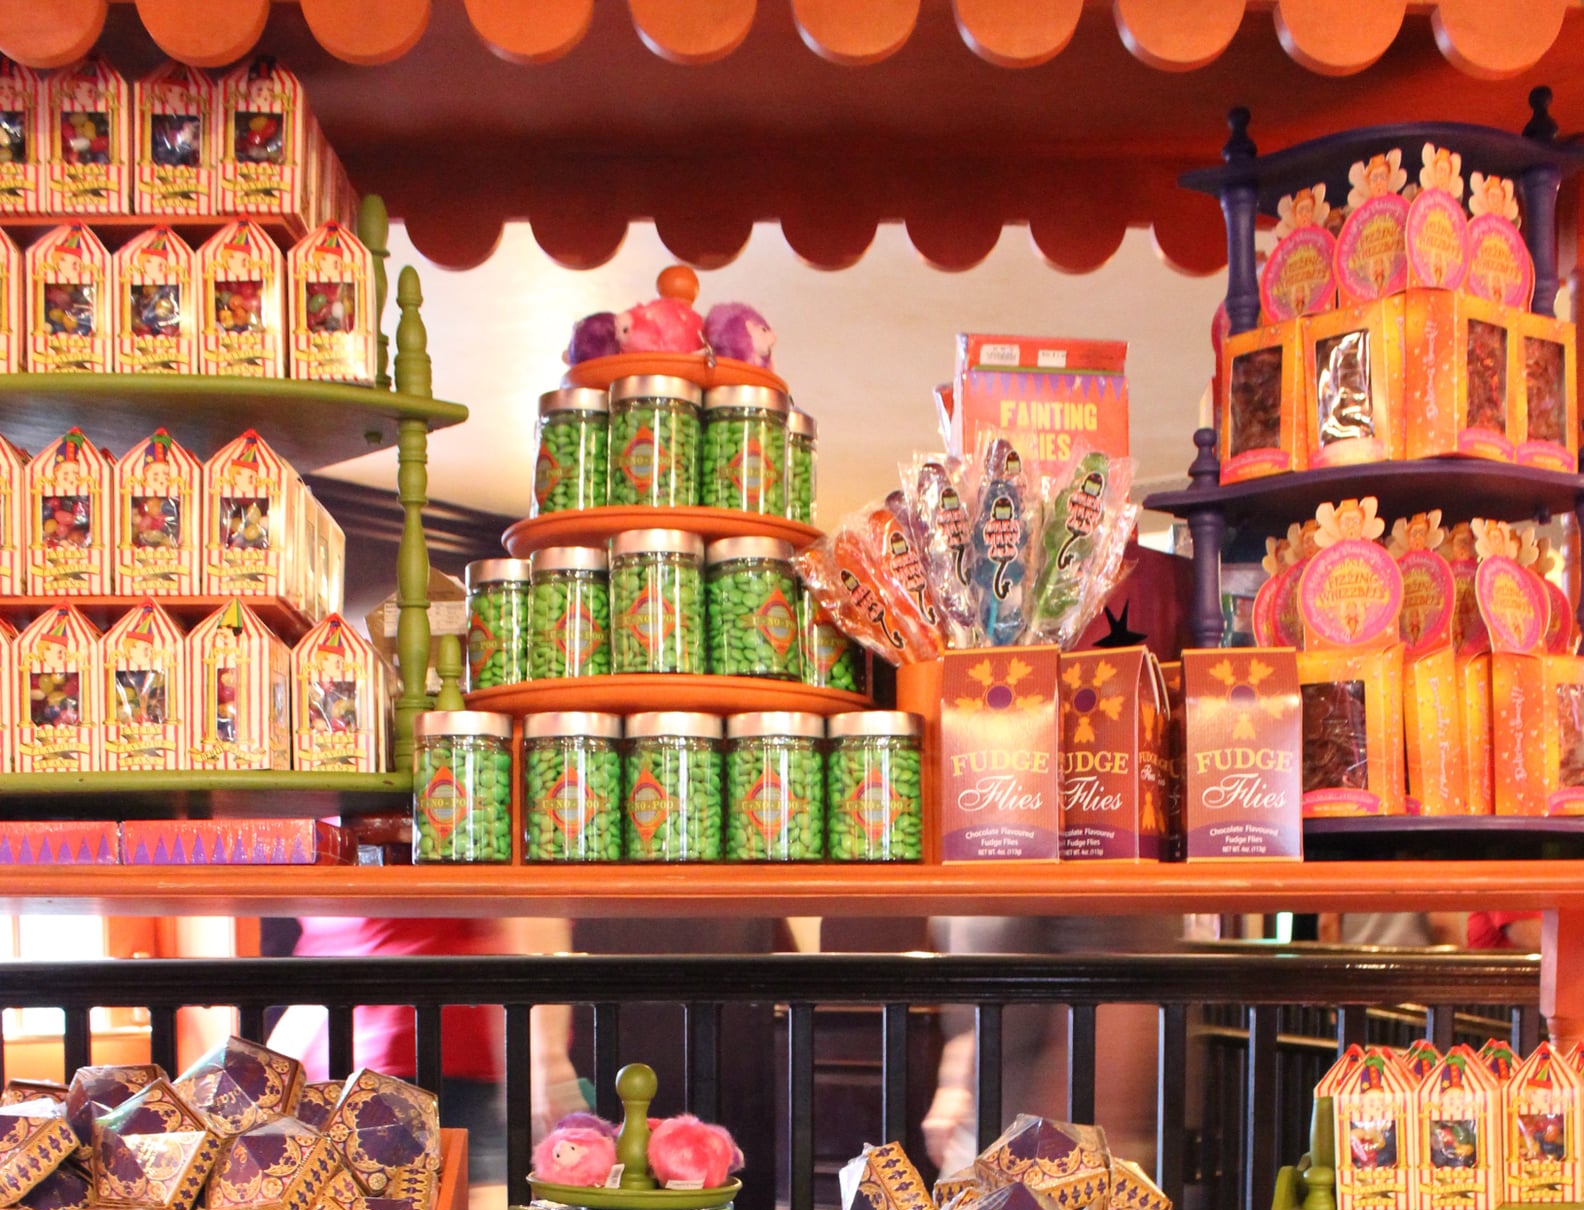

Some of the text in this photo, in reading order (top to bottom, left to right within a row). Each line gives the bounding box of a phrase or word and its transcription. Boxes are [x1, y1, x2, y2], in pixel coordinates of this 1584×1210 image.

[1000, 400, 1098, 431] FAINTING
[950, 749, 1050, 777] FUDGE
[1195, 747, 1294, 775] FUDGE
[957, 774, 1044, 813] Flies
[1202, 772, 1288, 809] Flies
[965, 827, 1035, 840] Chocolate Flavoured
[1085, 828, 1115, 839] Flavoured
[1209, 824, 1280, 838] Chocolate Flavoured
[981, 837, 1019, 847] Fudge Flies
[1067, 838, 1101, 848] Fudge Flies
[1225, 835, 1263, 845] Fudge Flies
